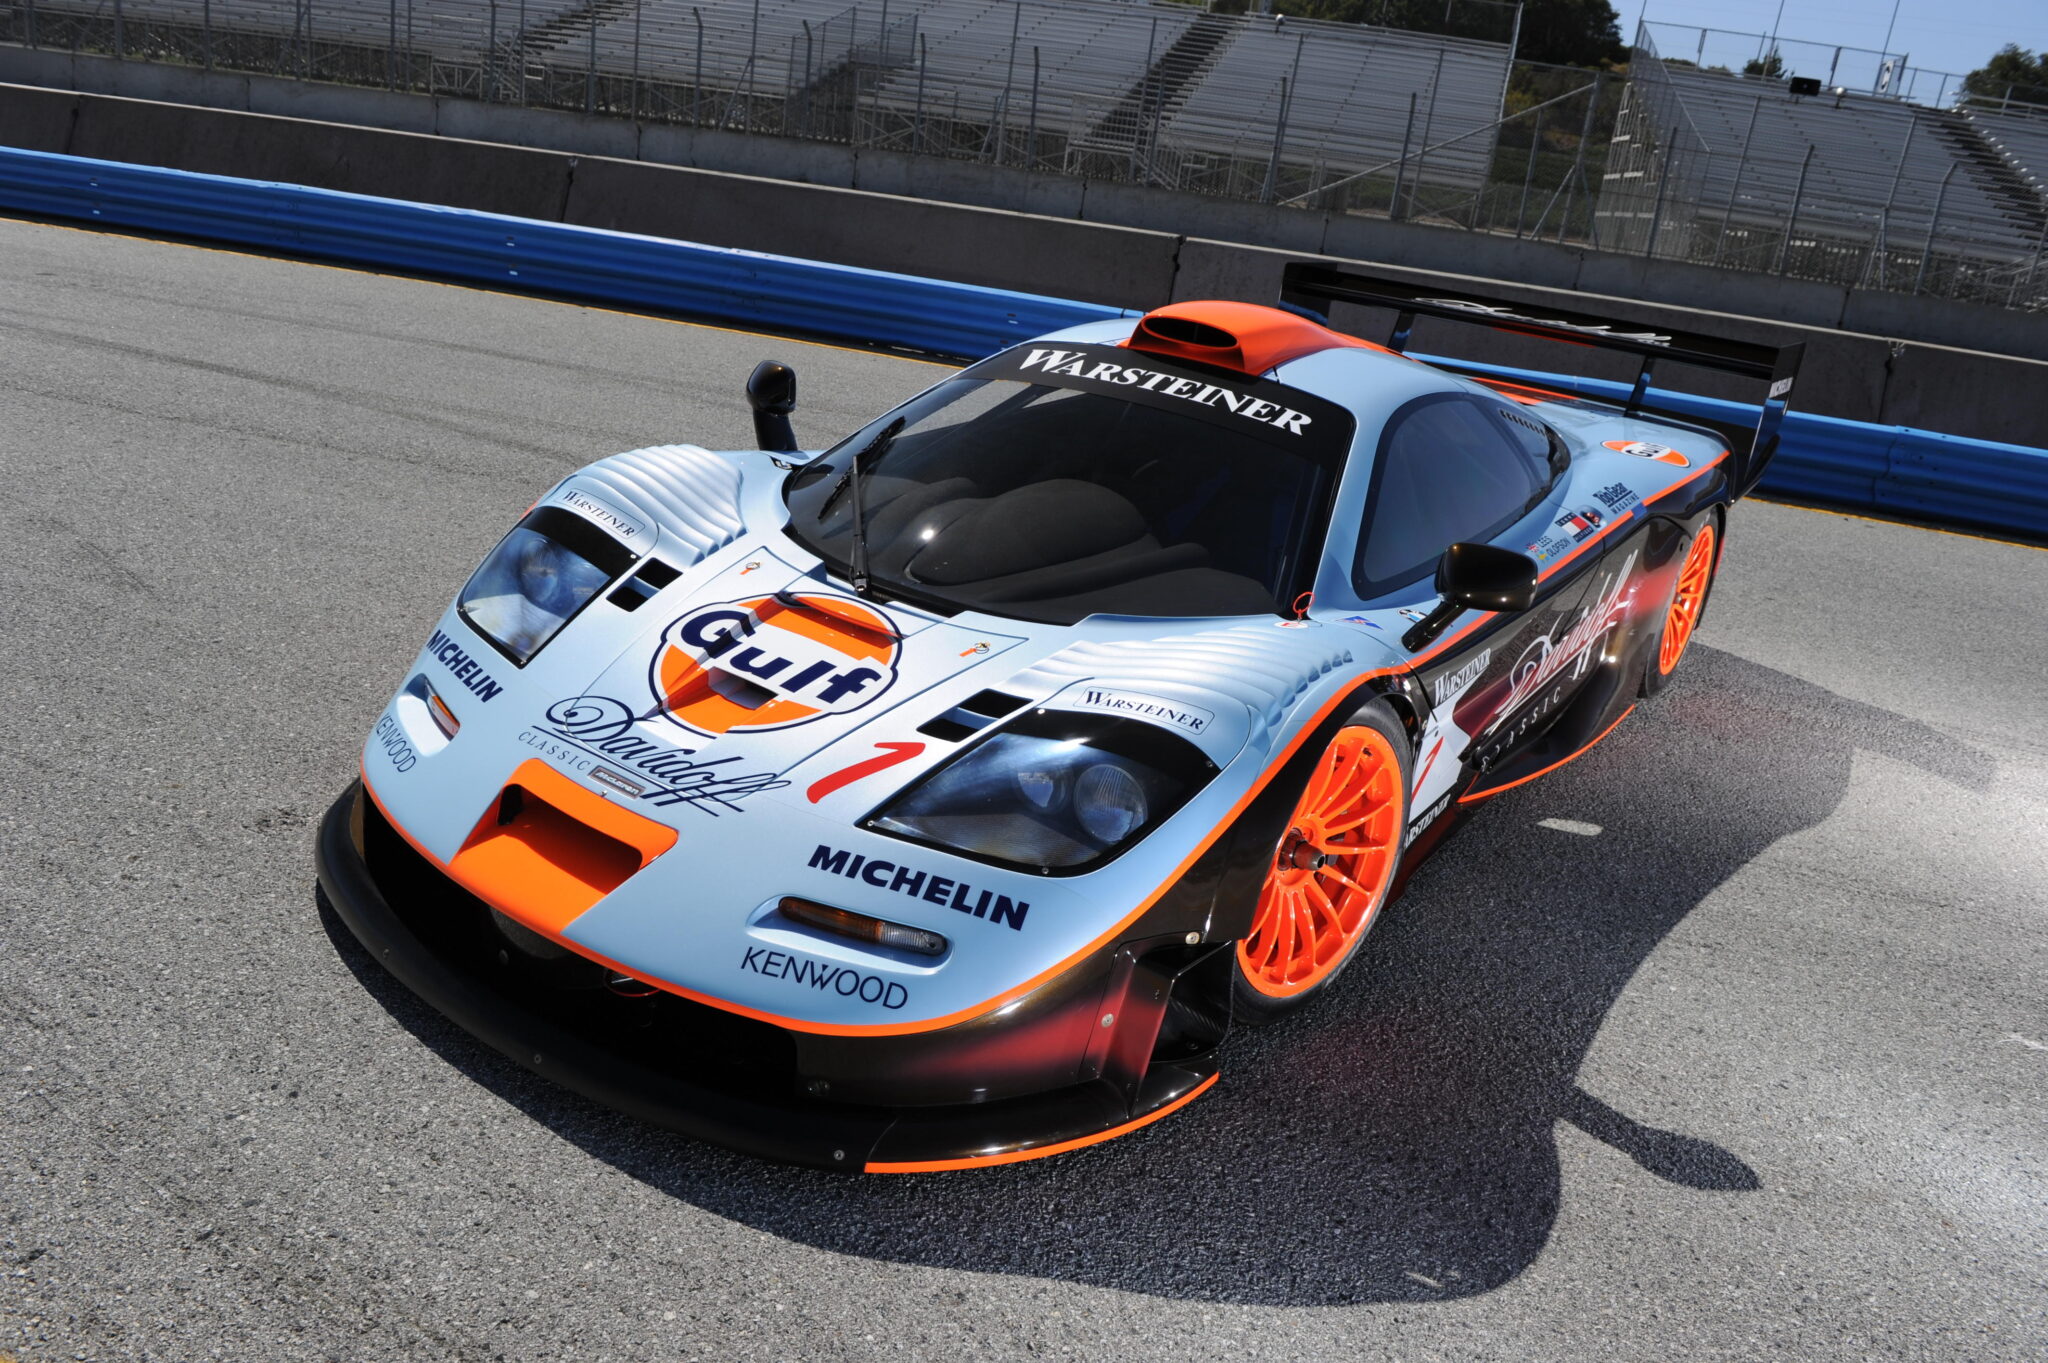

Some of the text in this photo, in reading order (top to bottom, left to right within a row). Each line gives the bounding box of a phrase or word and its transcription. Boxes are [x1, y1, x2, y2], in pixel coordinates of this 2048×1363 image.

[1019, 348, 1313, 436] WARSTEINER
[562, 490, 635, 538] WARSTEINER
[1610, 493, 1640, 515] MAGAZINE
[1536, 535, 1553, 548] LEES
[426, 629, 504, 703] MICHELIN
[681, 610, 882, 704] Gulf
[1434, 648, 1492, 707] WARSTEINER
[1084, 689, 1205, 732] WARSTEINER
[374, 712, 417, 774] KENWOOD
[518, 731, 590, 771] CLASSIC
[540, 696, 791, 817] Davidoff
[806, 742, 926, 804] 1
[1405, 793, 1451, 849] ARSTEINER
[807, 844, 1031, 932] MICHELIN
[740, 946, 909, 1010] KENWOOD
